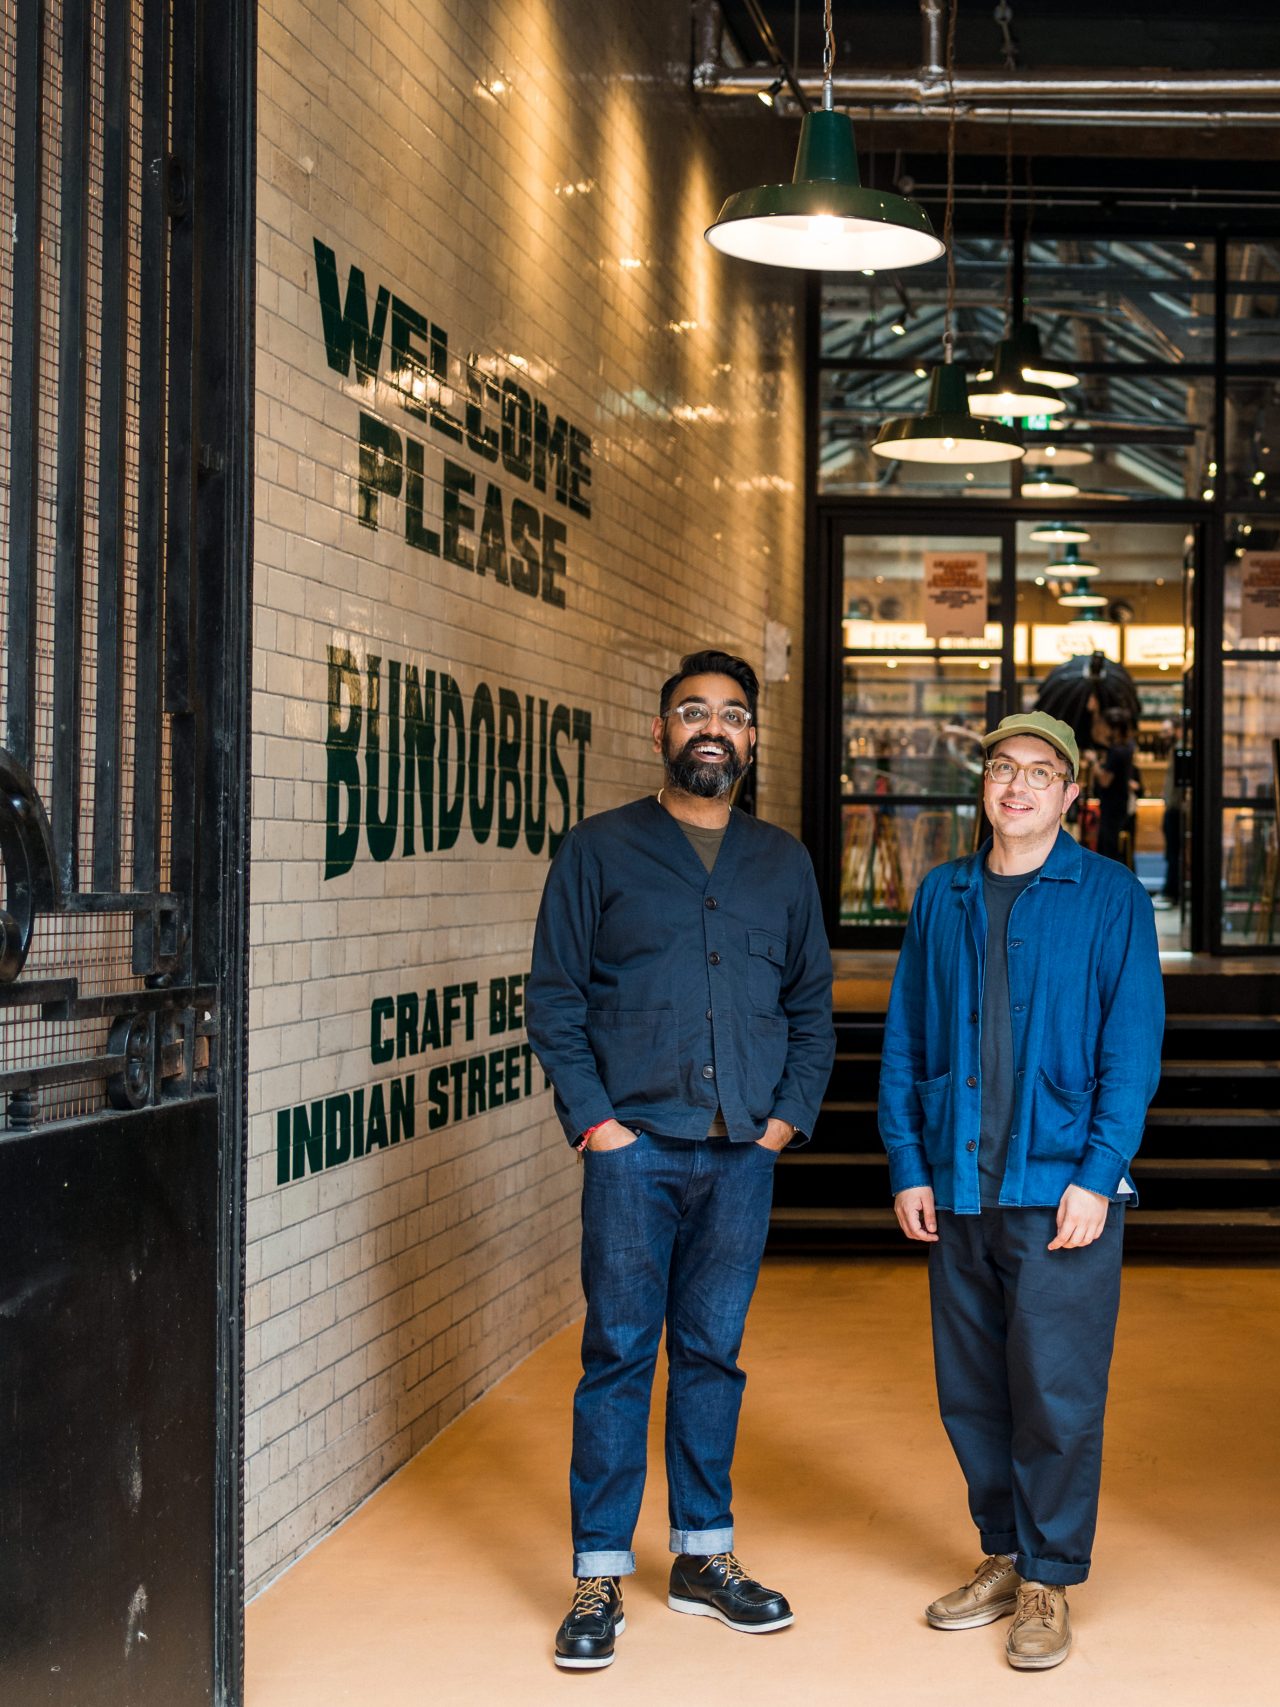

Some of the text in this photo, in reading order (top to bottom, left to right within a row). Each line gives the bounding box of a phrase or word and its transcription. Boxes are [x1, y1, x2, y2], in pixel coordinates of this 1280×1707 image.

[313, 237, 592, 519] WELCOME
[358, 411, 567, 609] PLEASE
[324, 644, 592, 881] BUNDOBUST
[277, 1043, 534, 1186] INDIAN STREET
[370, 973, 531, 1065] CRAFT BE
